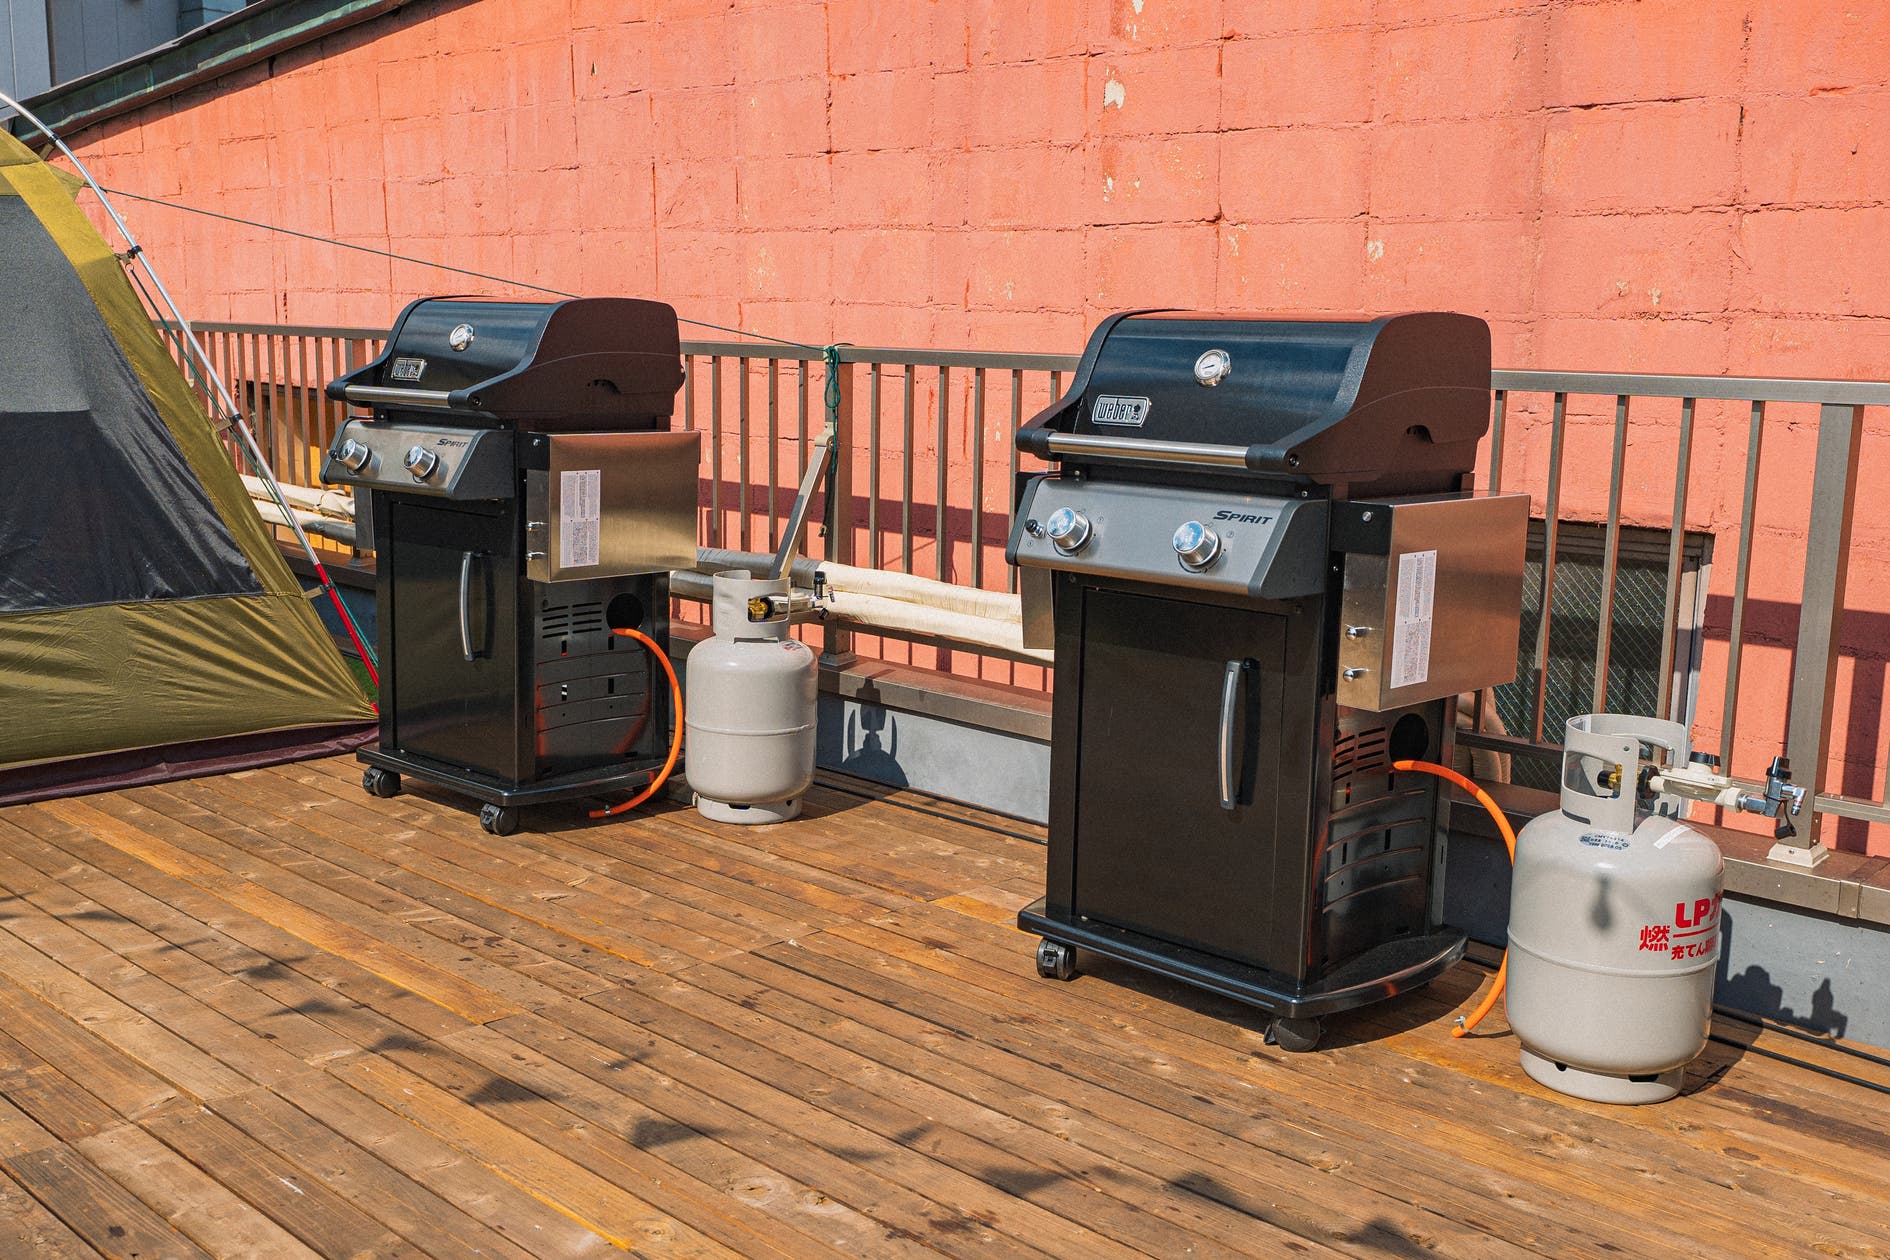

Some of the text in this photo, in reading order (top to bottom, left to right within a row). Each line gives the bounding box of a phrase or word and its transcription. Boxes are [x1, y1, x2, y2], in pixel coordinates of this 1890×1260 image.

[1097, 397, 1133, 420] weber
[437, 438, 468, 448] SPIRIT
[1213, 510, 1273, 524] SPIRIT
[1639, 925, 1670, 951] 燃
